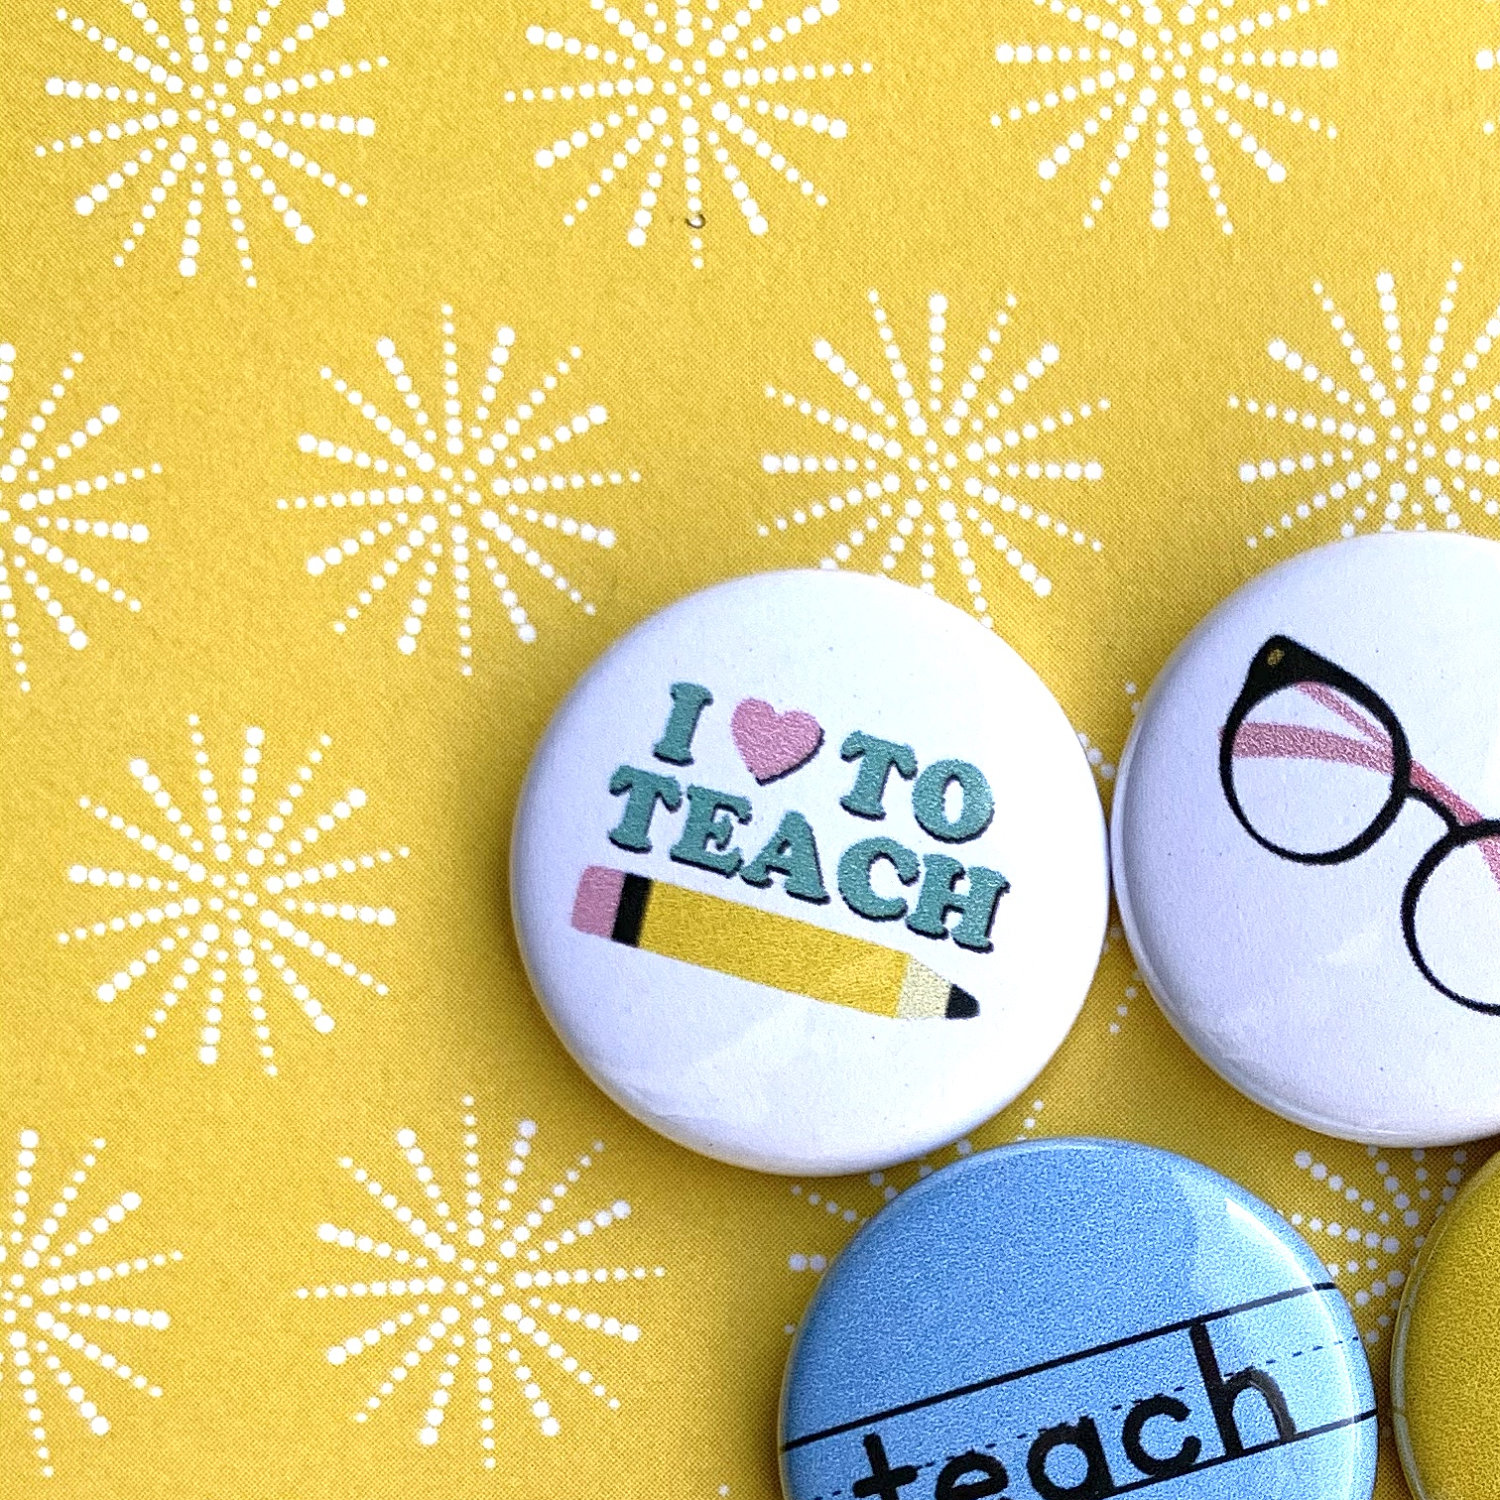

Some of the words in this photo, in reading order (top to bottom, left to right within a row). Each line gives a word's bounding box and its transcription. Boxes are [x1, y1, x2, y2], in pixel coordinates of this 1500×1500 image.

[652, 681, 714, 767] I
[839, 729, 995, 844] TO
[608, 763, 1012, 954] TEACH
